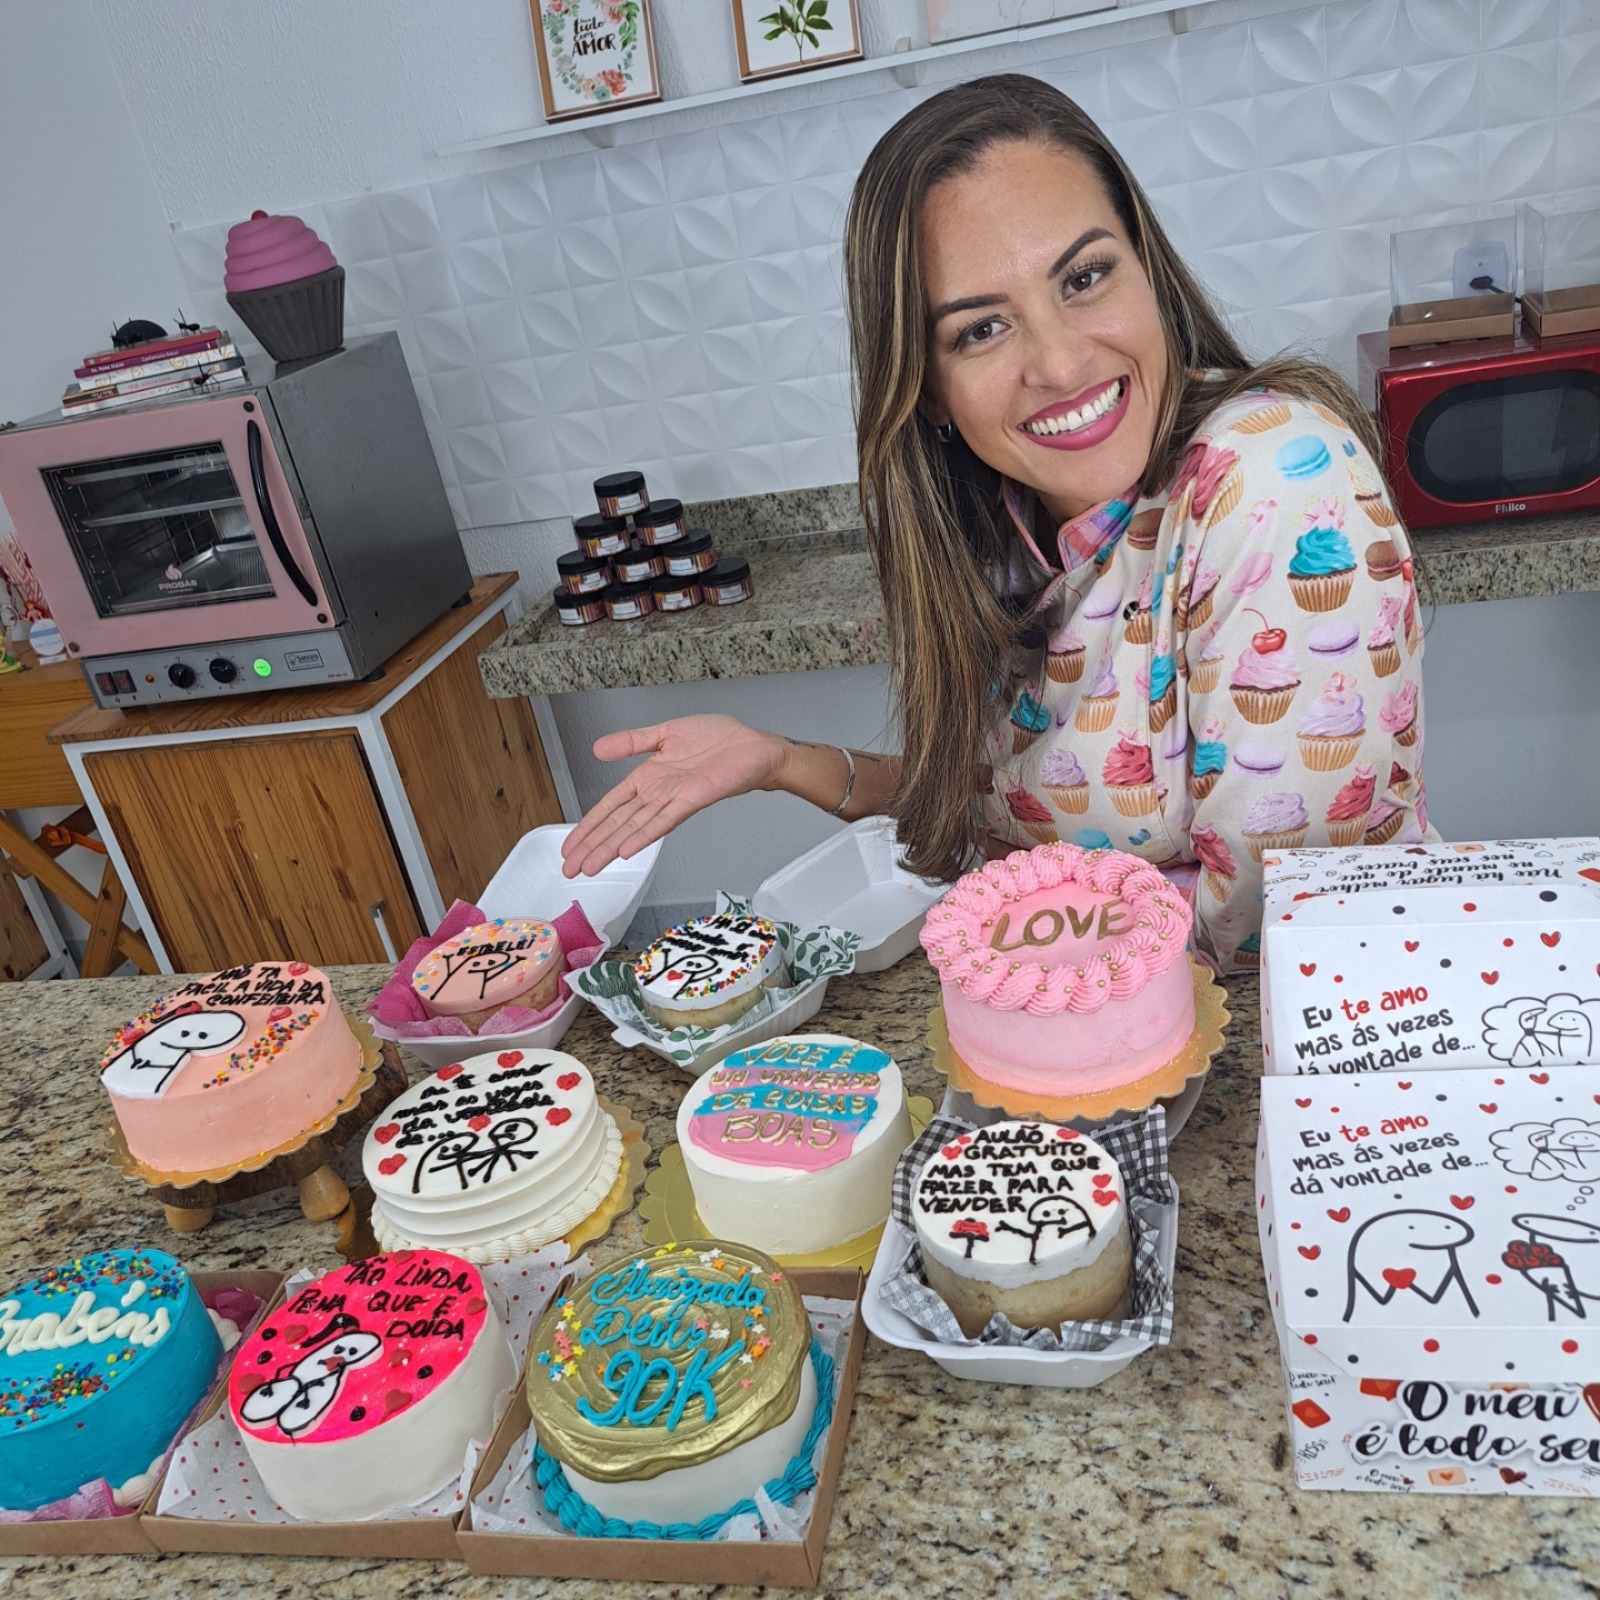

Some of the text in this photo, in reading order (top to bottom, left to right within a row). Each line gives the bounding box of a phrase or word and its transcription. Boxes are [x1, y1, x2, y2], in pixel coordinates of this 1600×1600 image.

[574, 16, 605, 34] tudo
[572, 33, 617, 57] AMOR
[1495, 503, 1526, 514] Philco
[1427, 856, 1471, 865] seus
[1479, 853, 1515, 861] nos
[1336, 871, 1376, 881] que
[1385, 869, 1412, 879] do
[1396, 873, 1463, 885] lugar
[1423, 863, 1498, 876] mundo
[1316, 881, 1388, 893] melhor
[989, 898, 1134, 952] LOVE
[212, 963, 253, 982] NÃO
[176, 979, 324, 997] FACIL A VIDA DA
[1302, 986, 1429, 1030] Eu te amo
[1294, 1008, 1454, 1060] mas ás vezes
[709, 1066, 882, 1091] UM UNIVERSO
[711, 1088, 869, 1115] DE COISAS
[720, 1112, 839, 1151] BOAS
[973, 1123, 1044, 1145] AULÃO
[1299, 1115, 1430, 1149] Eu te amo
[963, 1138, 1088, 1160] GRATUITO
[1292, 1132, 1461, 1173] mas ás vezes
[927, 1155, 1101, 1179] MAS TEM QUE
[919, 1175, 1074, 1195] FAZER PARA
[1289, 1173, 1325, 1196] dá
[918, 1196, 1028, 1214] VENDER
[344, 1256, 389, 1287] TÃO
[287, 1288, 348, 1315] PENA
[366, 1289, 431, 1313] QUE
[0, 1280, 171, 1357] rabéns
[385, 1313, 465, 1341] DOIDA
[580, 1306, 708, 1350] Deus
[576, 1338, 746, 1432] 90K
[1403, 1380, 1580, 1422] O meu
[1355, 1424, 1389, 1456] é
[1398, 1423, 1528, 1462] todo
